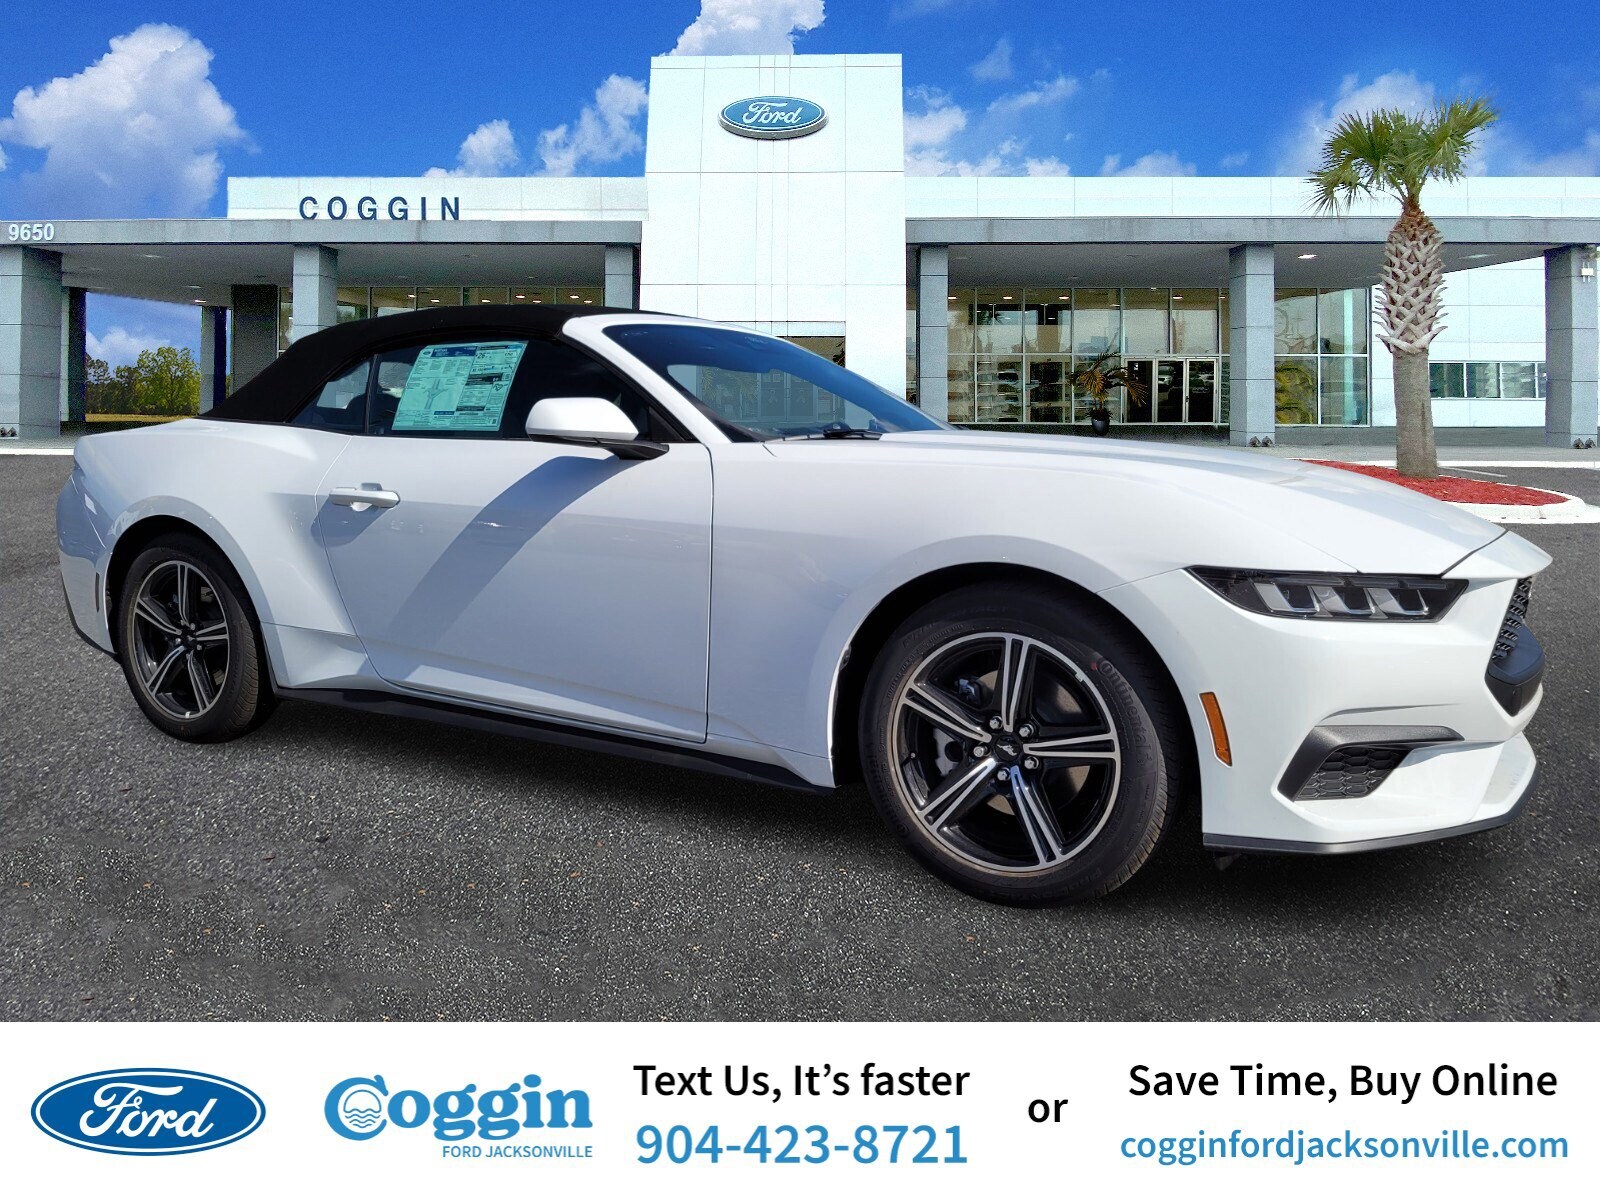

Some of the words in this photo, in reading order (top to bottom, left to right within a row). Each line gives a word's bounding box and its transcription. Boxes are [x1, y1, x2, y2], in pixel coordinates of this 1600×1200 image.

[742, 101, 803, 124] Ford
[298, 195, 460, 220] COGGIN
[8, 223, 55, 241] 9650
